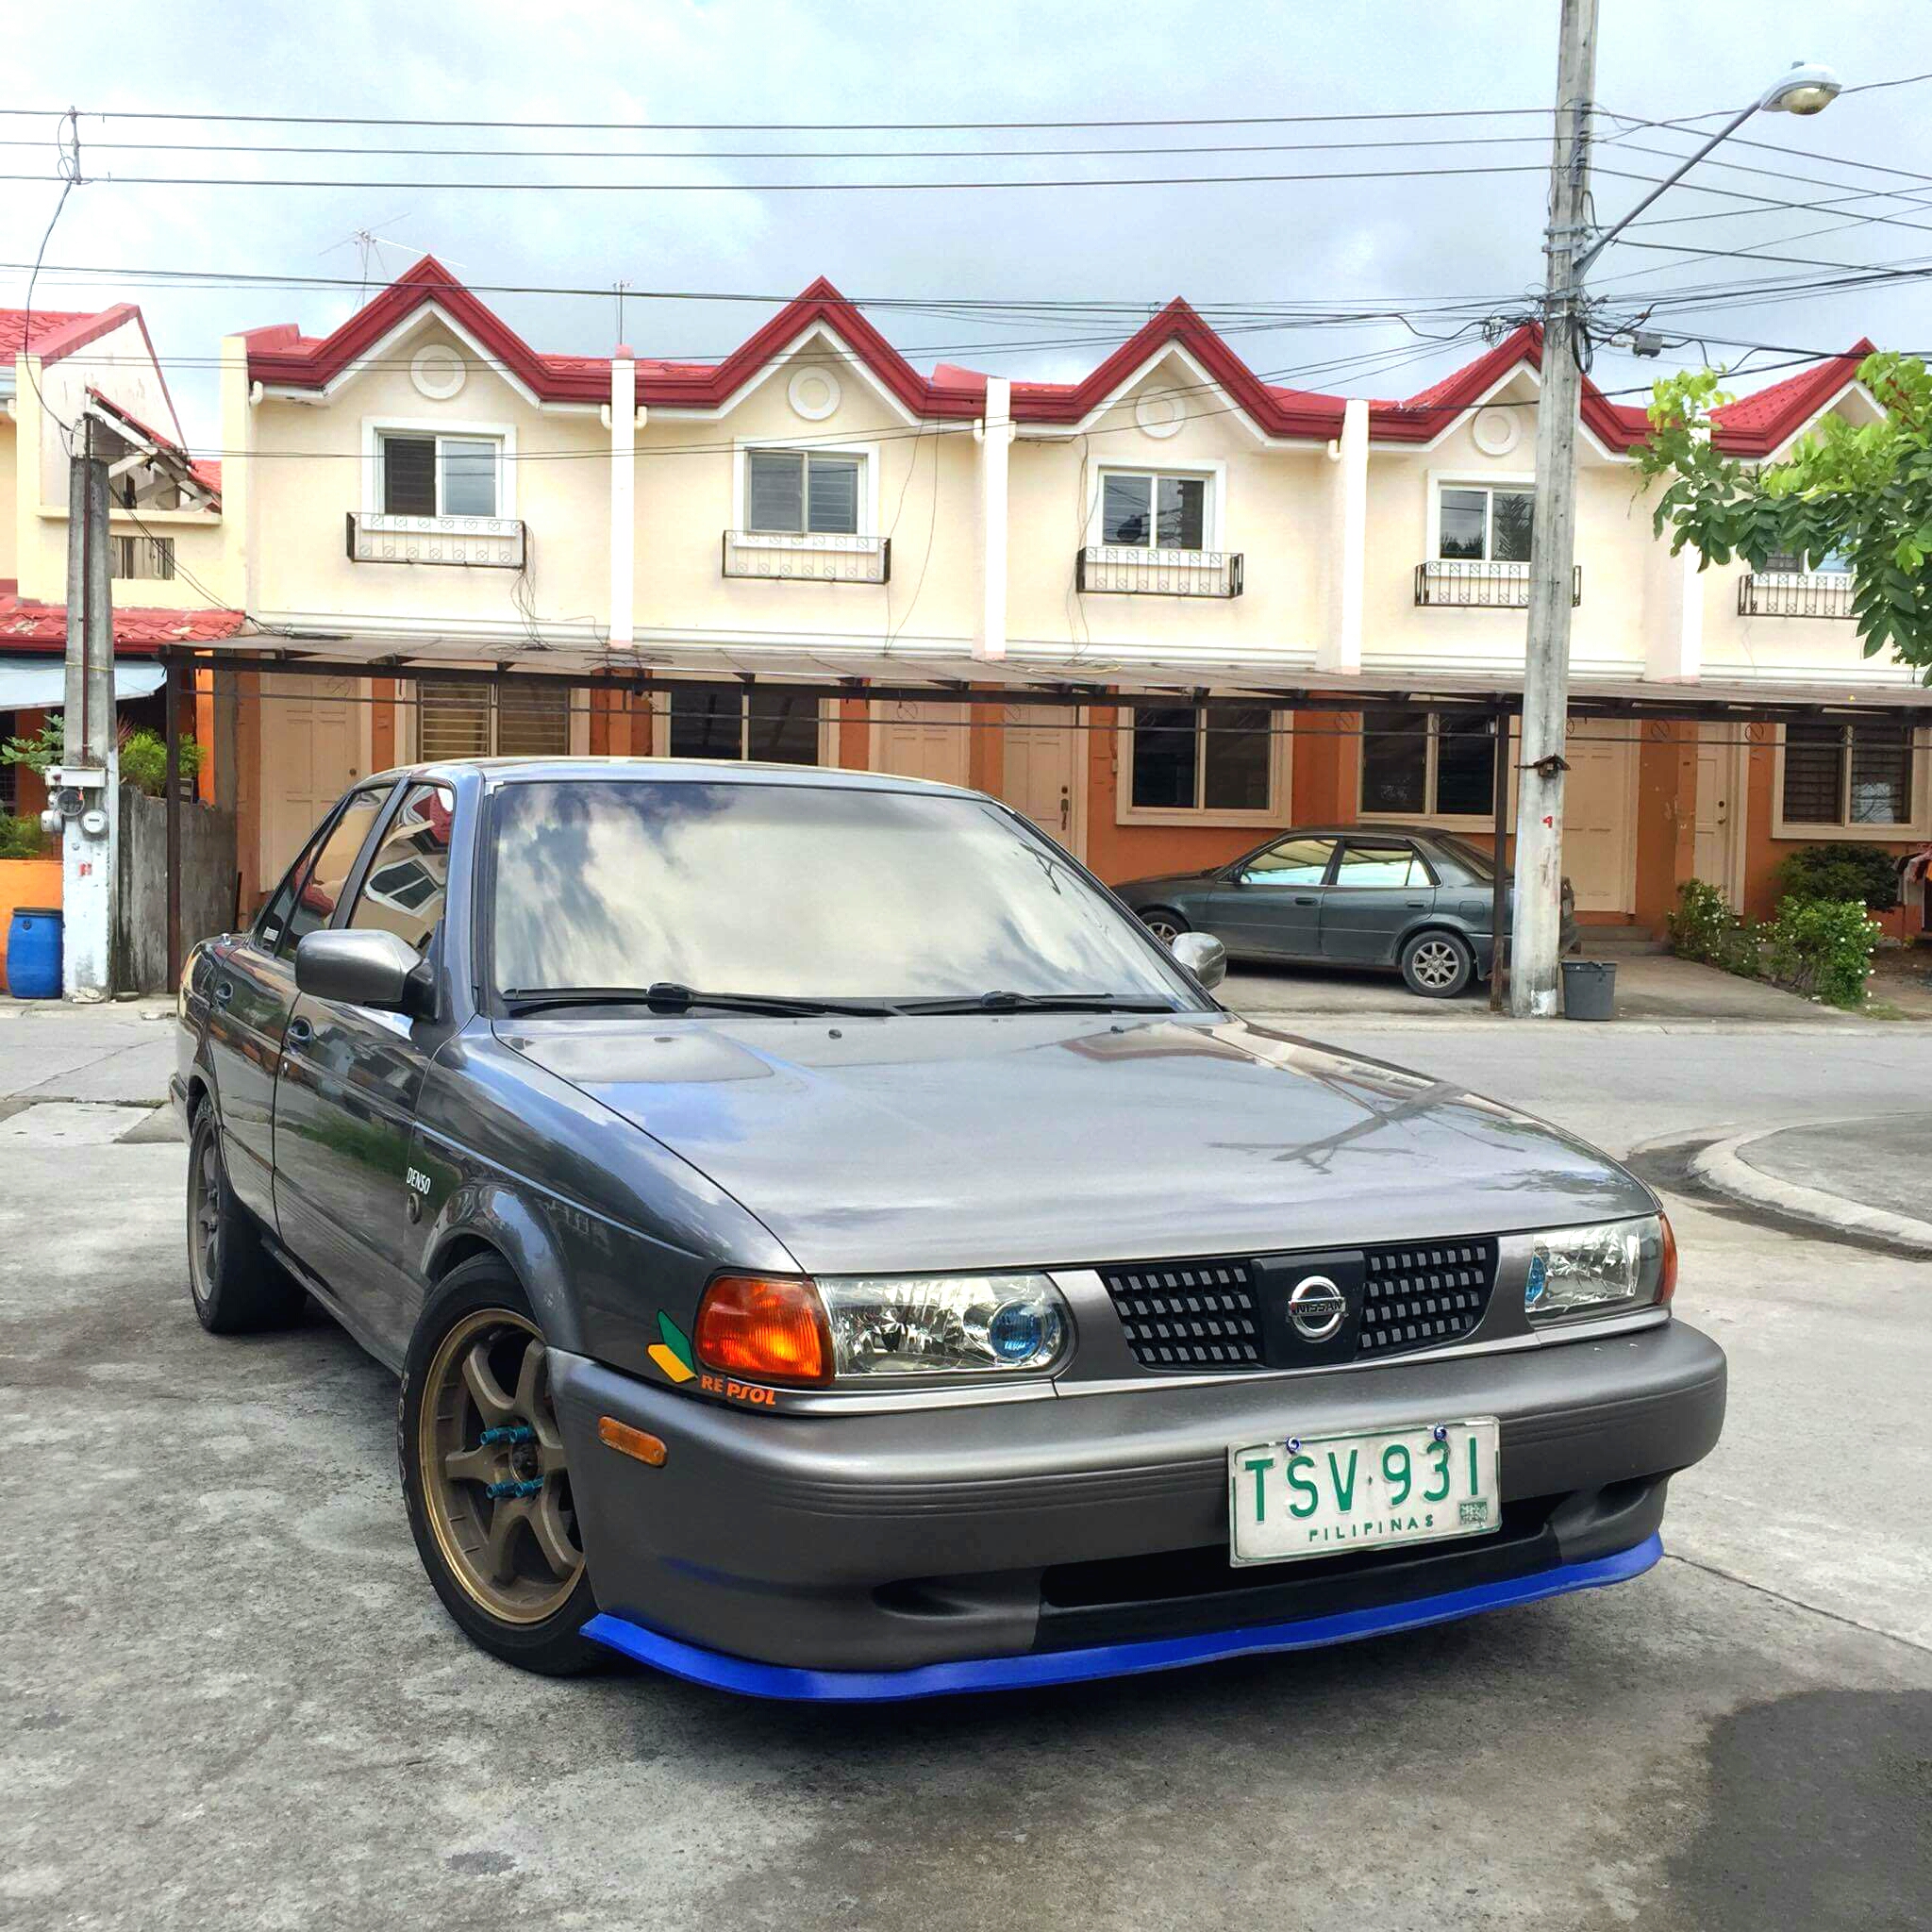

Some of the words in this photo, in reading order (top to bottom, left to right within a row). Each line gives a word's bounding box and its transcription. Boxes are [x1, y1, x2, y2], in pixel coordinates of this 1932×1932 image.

[406, 1166, 431, 1195] DENSO
[1296, 1300, 1341, 1313] NISSAN
[1244, 1448, 1358, 1522] TSV
[1382, 1437, 1478, 1506] 931
[1308, 1513, 1435, 1542] PILIPINAS
